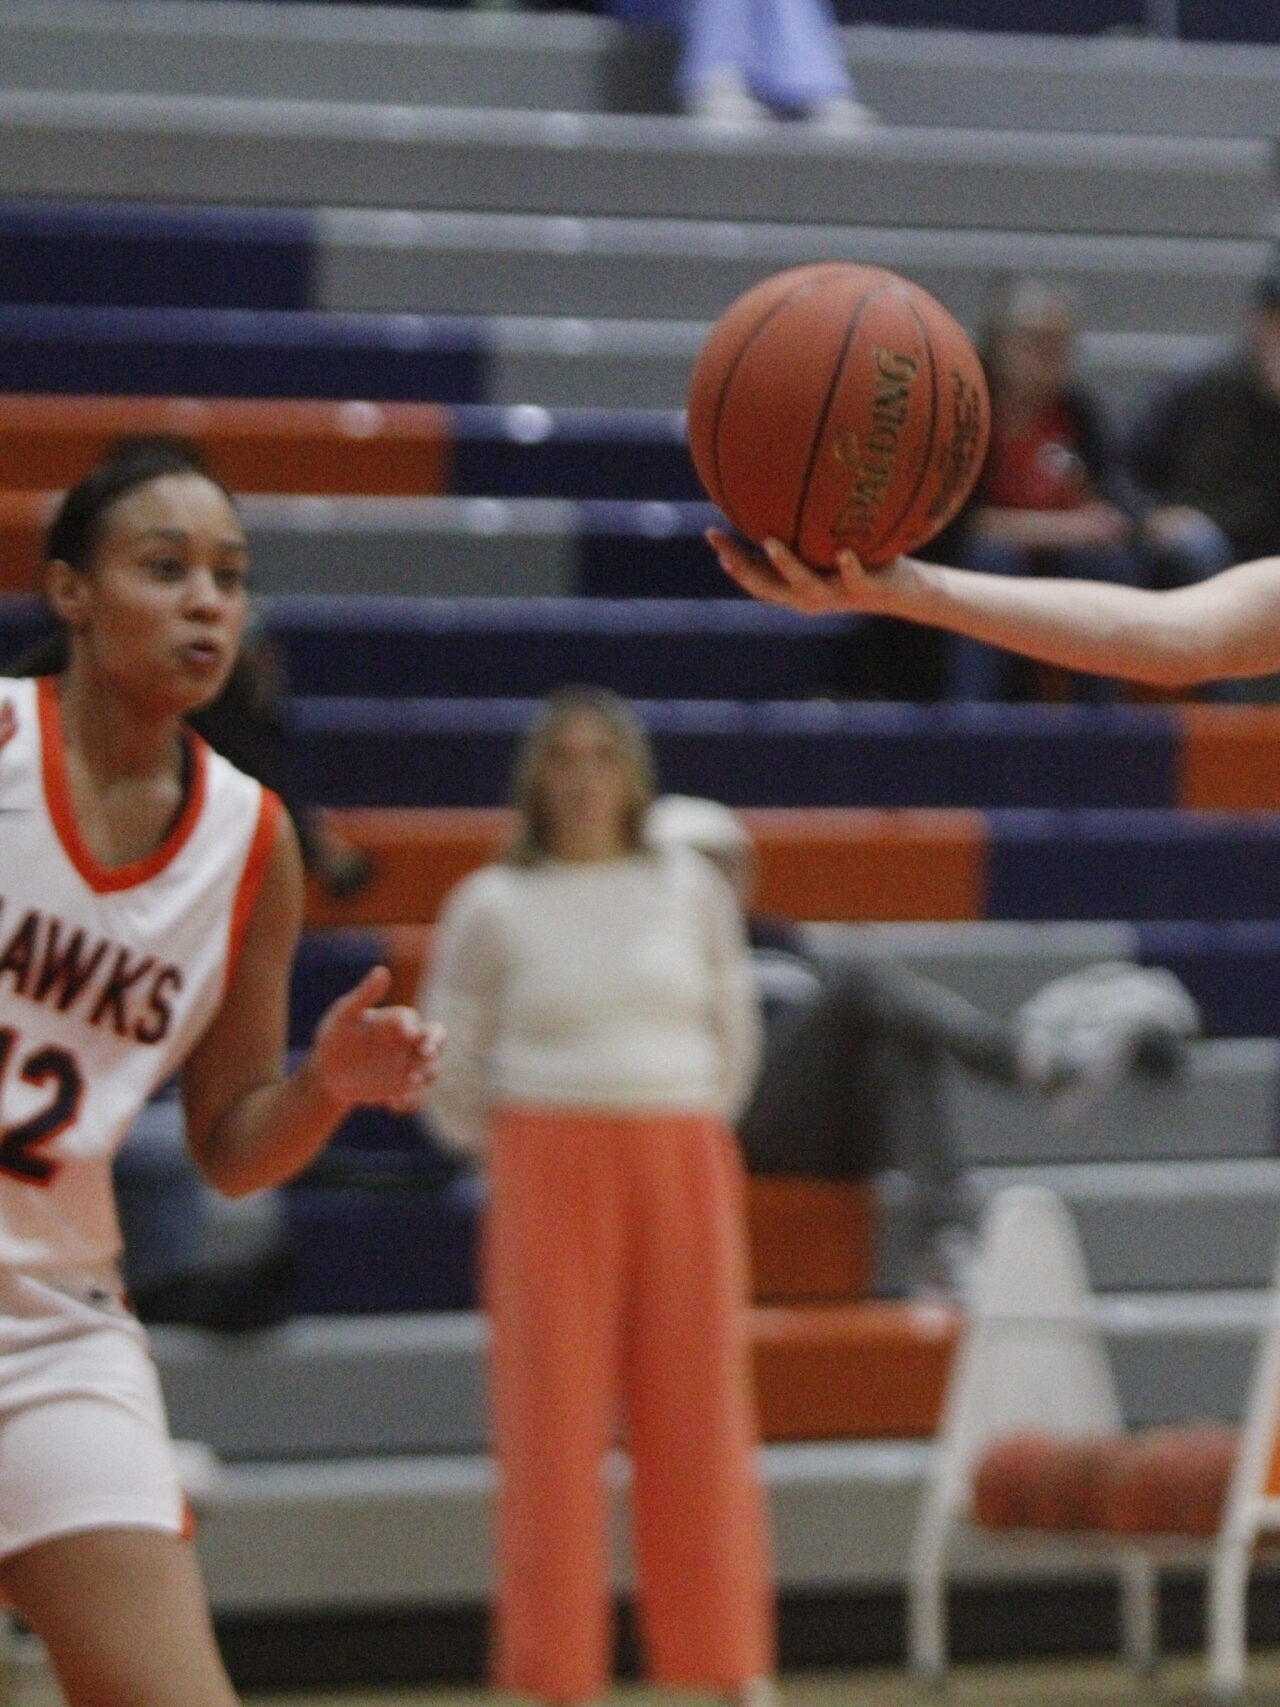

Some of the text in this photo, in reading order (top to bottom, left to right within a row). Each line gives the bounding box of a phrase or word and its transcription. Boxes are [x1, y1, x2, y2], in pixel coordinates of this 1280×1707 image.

[830, 346, 919, 544] SPALDING
[0, 896, 183, 1045] AWKS
[0, 1024, 85, 1187] 2
